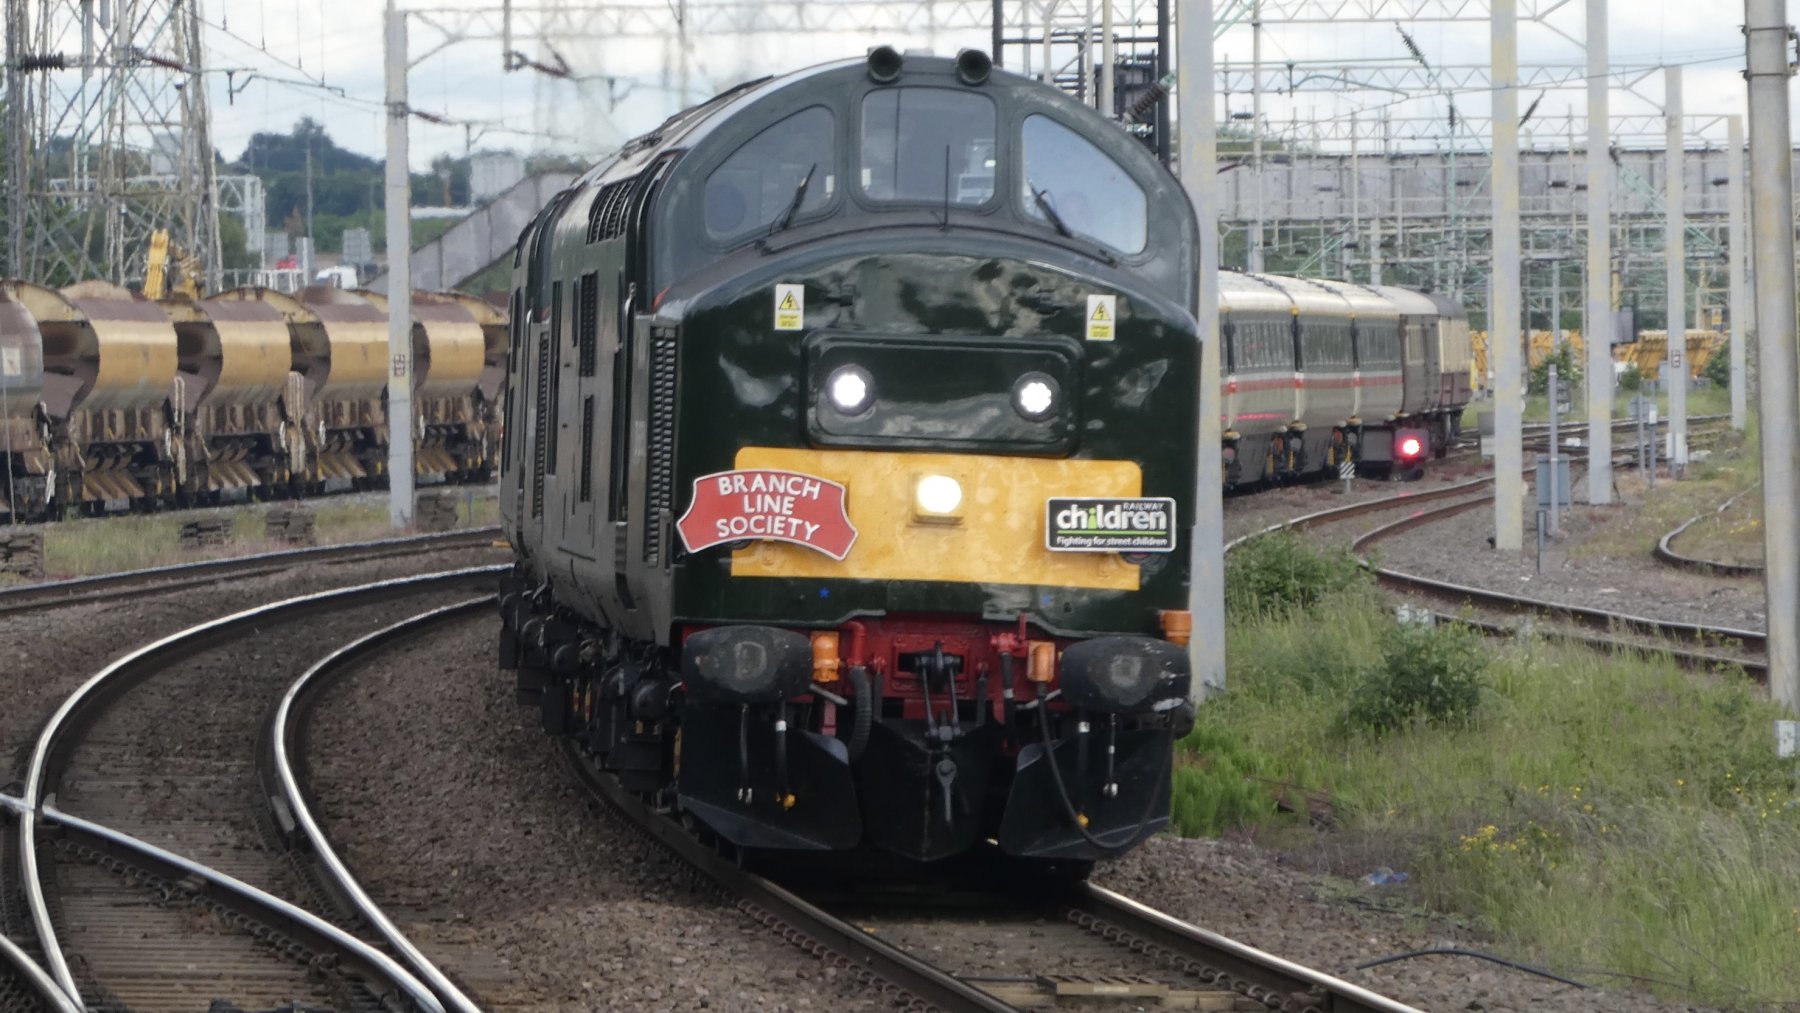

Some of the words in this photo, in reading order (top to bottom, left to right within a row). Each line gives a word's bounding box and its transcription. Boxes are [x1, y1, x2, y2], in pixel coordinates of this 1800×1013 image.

[718, 473, 822, 500] BRANCH
[743, 494, 795, 515] LINE
[1123, 502, 1165, 511] RAILWAY
[716, 515, 821, 541] SOCIETY
[1056, 504, 1167, 529] children
[1056, 536, 1092, 547] Fighting
[1093, 536, 1106, 545] for
[1106, 537, 1131, 546] street
[1132, 536, 1168, 546] children
